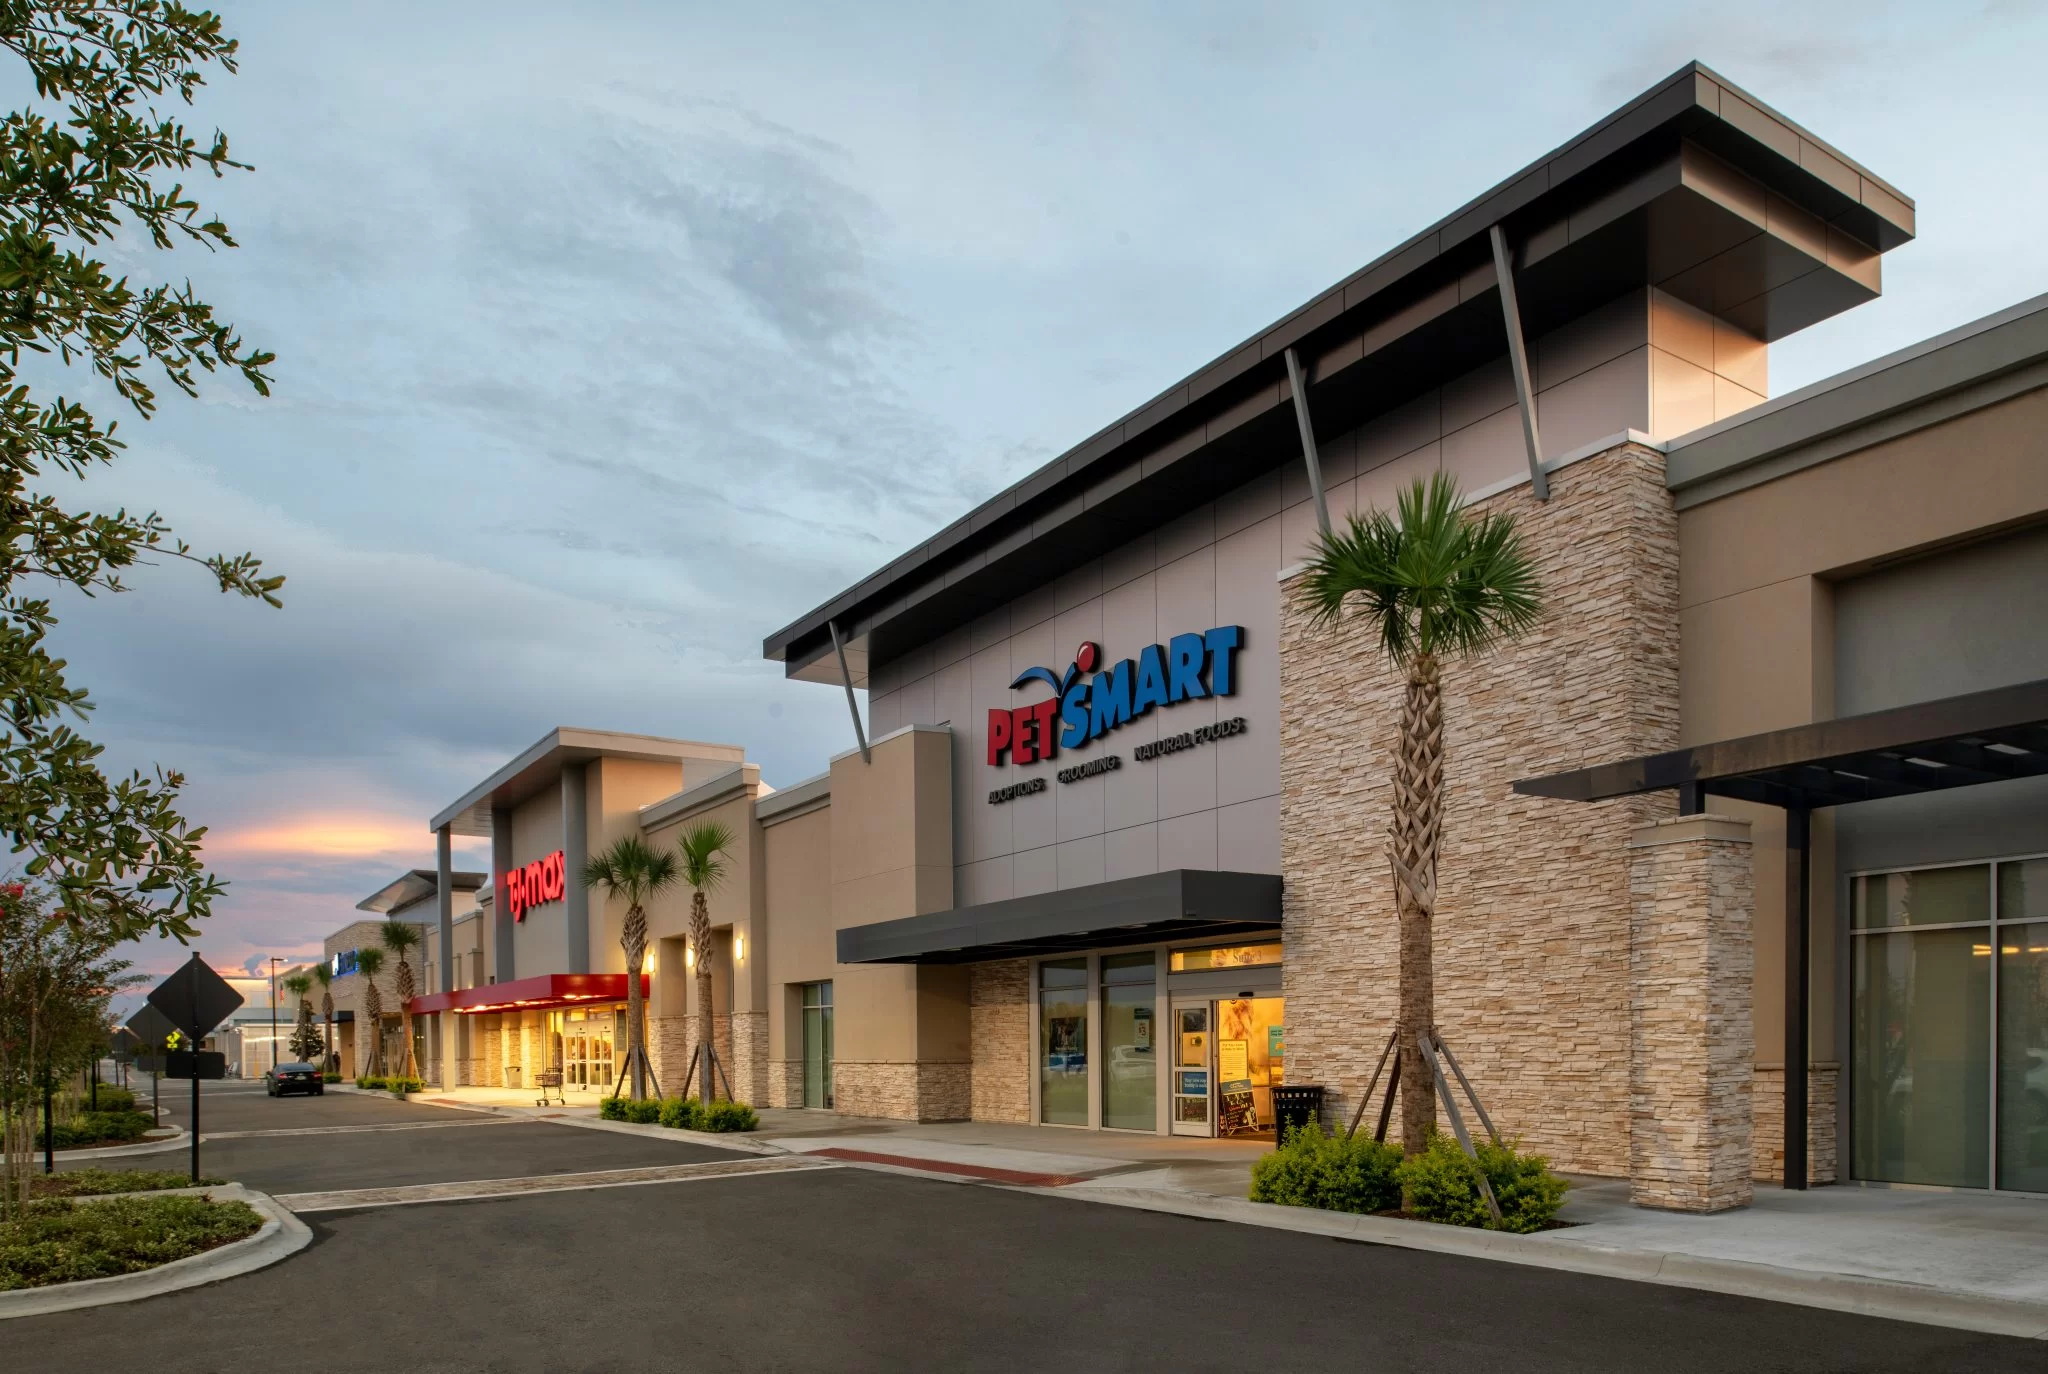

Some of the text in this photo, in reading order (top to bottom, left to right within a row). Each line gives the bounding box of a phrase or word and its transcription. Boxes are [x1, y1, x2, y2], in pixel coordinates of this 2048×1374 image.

[988, 625, 1243, 765] PETSMART
[988, 717, 1245, 804] ADOPTIONS GROOMING NATURAL FOODS
